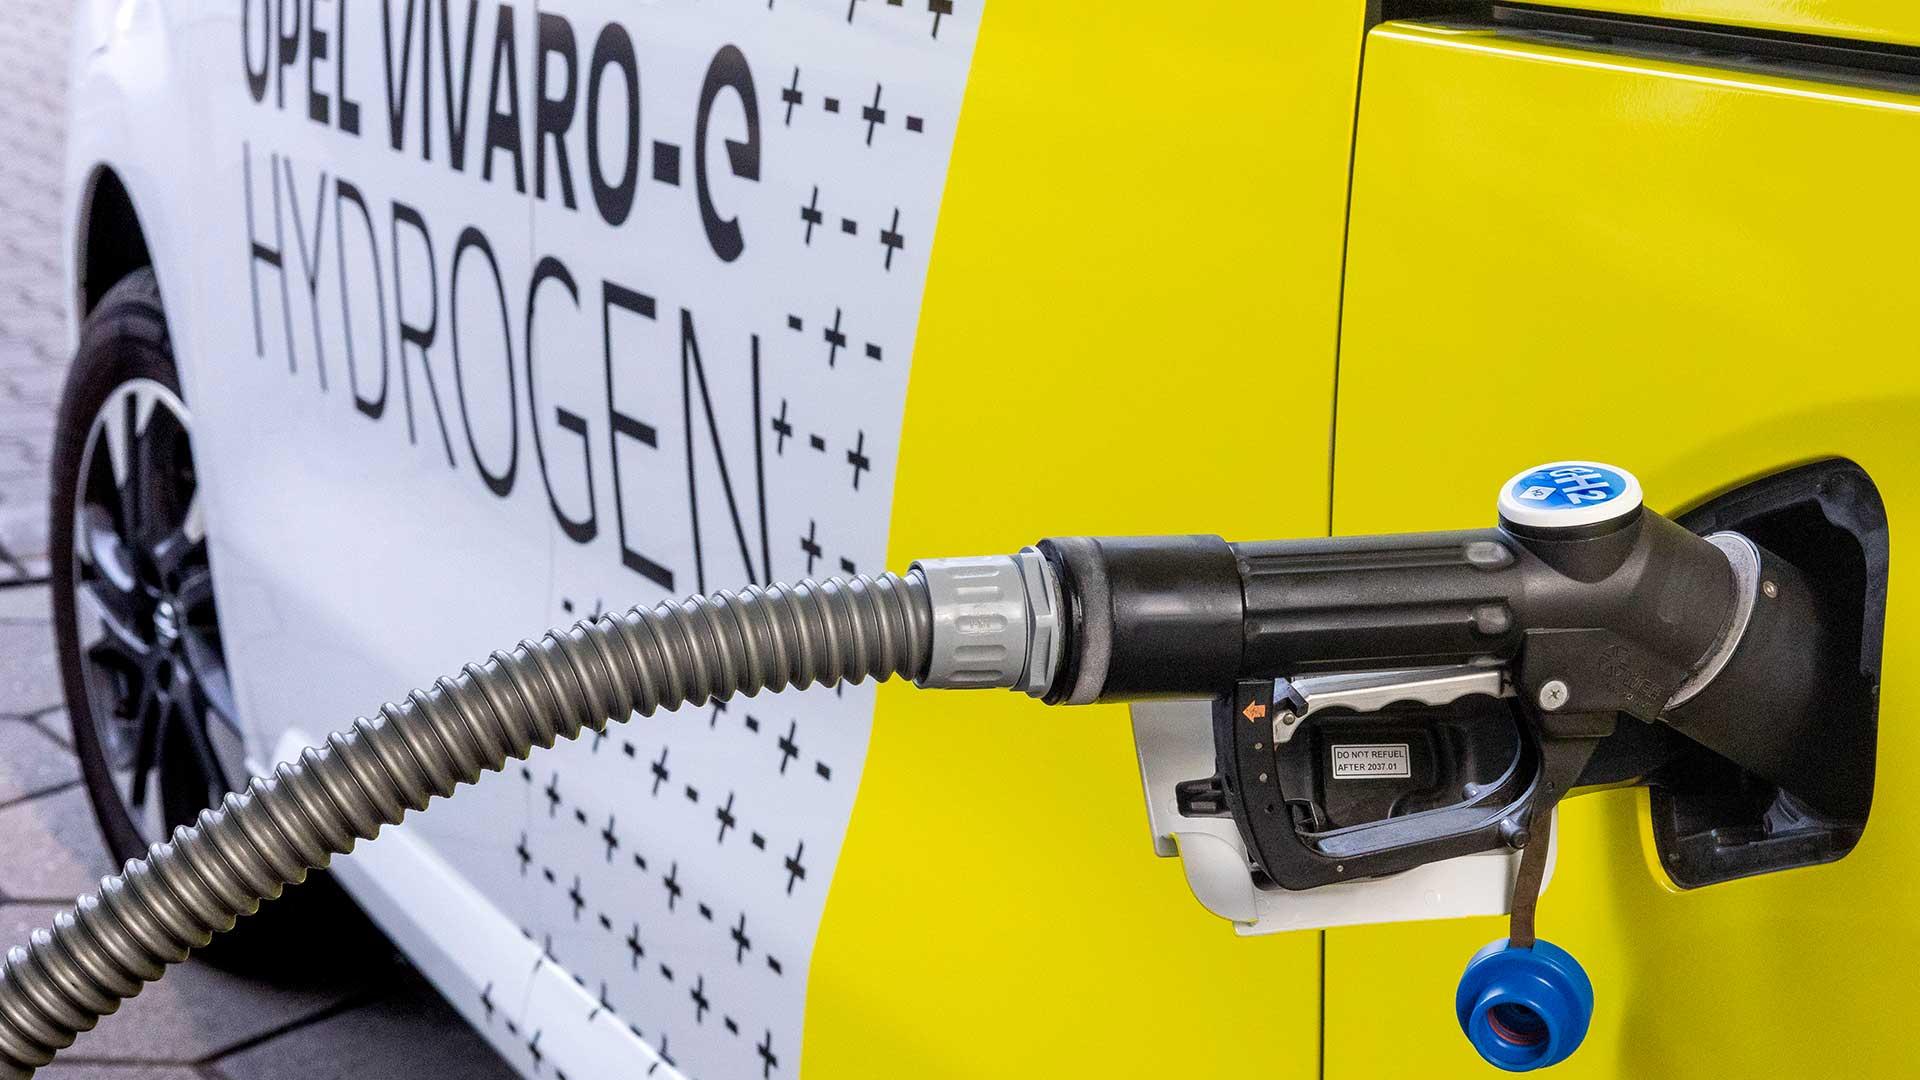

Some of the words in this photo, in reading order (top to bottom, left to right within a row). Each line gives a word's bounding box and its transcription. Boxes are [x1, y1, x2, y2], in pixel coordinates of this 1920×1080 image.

[242, 0, 360, 136] OPEL
[381, 0, 761, 263] VIVARO-e
[243, 139, 772, 596] HYDROGEN
[1337, 751, 1350, 759] DO
[1351, 751, 1369, 759] NOT
[1371, 750, 1404, 758] REFUEL
[1367, 763, 1397, 771] 2037.01
